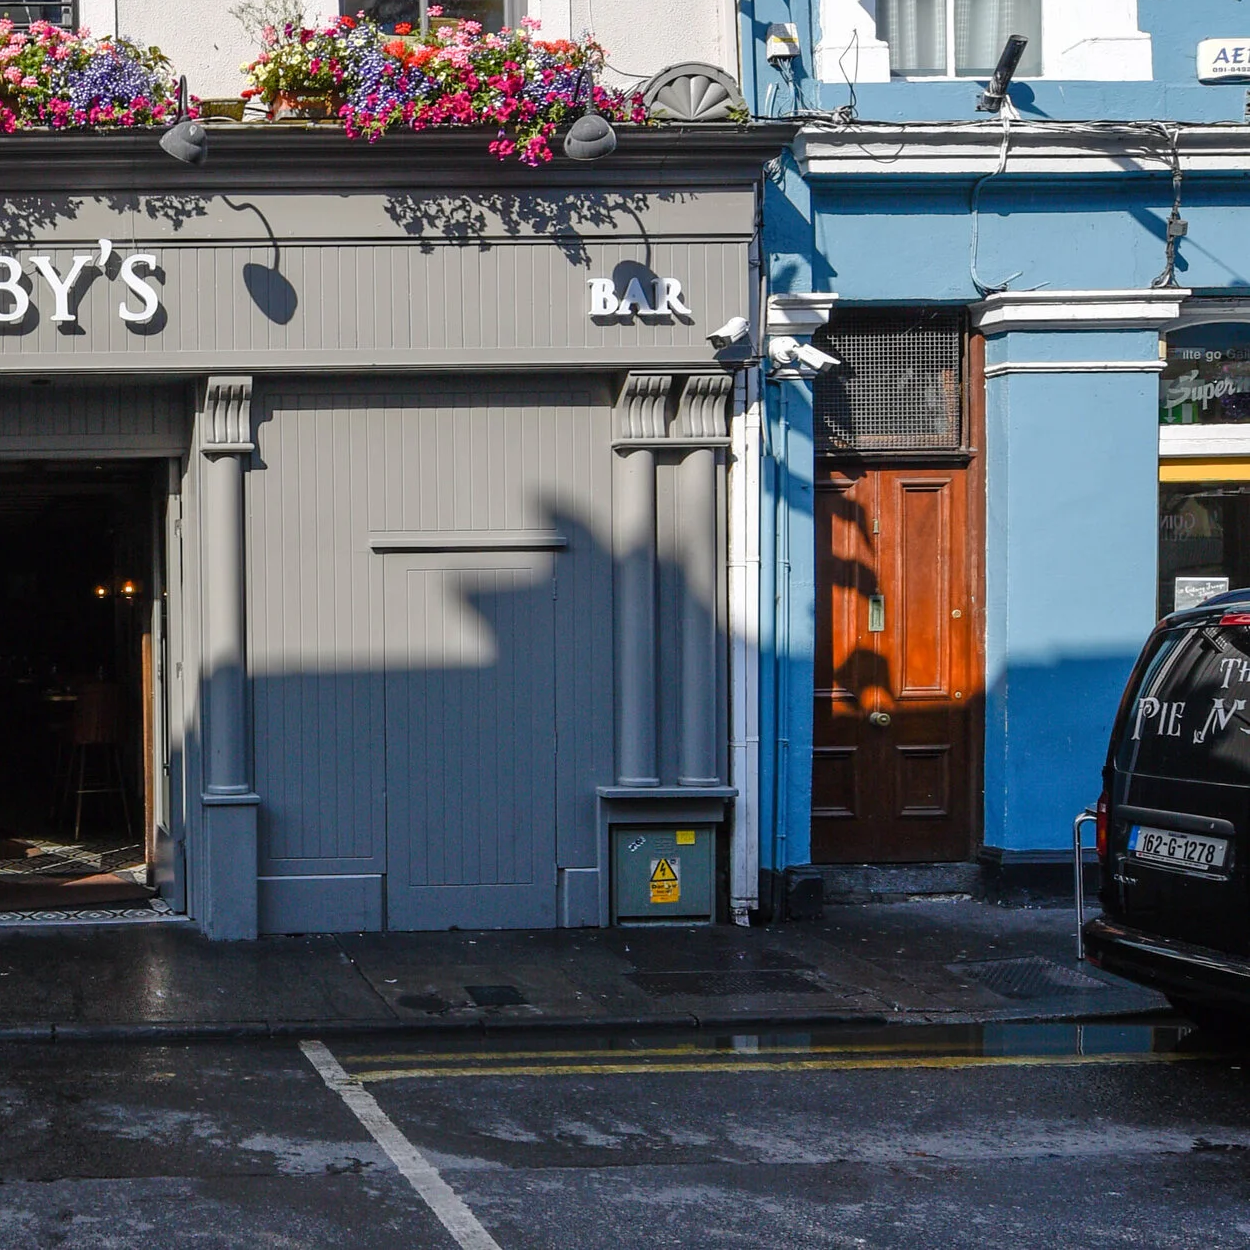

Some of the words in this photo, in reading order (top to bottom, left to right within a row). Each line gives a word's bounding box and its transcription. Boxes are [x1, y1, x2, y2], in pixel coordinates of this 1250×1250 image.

[587, 277, 692, 315] BAR
[1205, 351, 1222, 362] go
[1131, 696, 1186, 740] PIE
[1142, 833, 1216, 863] 162-G-1278
